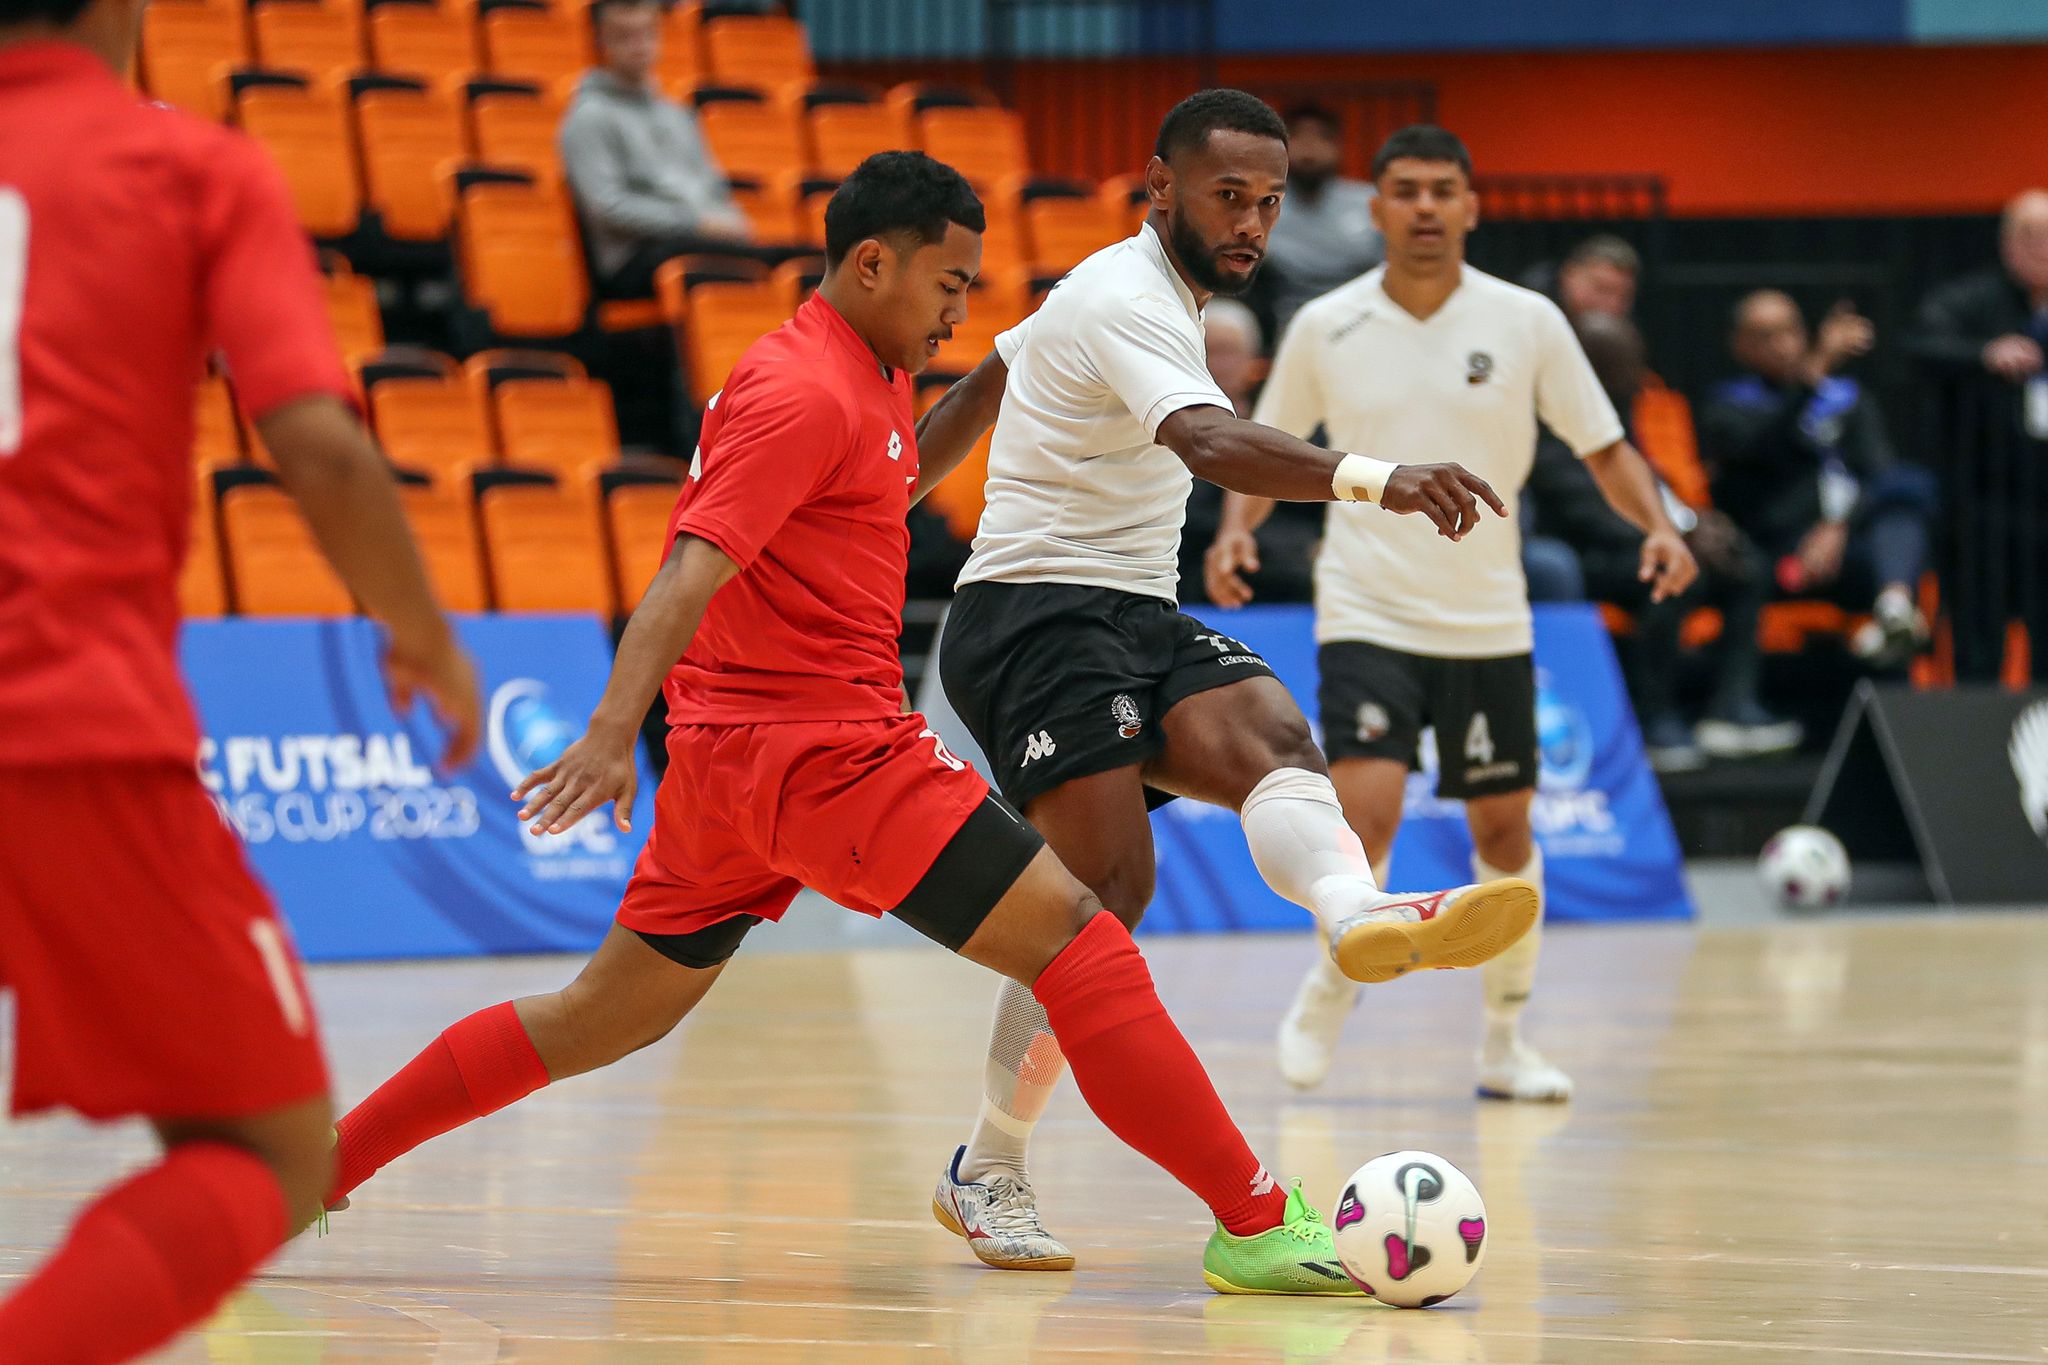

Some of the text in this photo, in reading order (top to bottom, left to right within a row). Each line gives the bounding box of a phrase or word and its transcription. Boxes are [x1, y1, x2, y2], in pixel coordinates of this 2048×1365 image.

[225, 732, 432, 793] FUTSAL
[1463, 710, 1496, 764] 4
[274, 791, 367, 843] CUP
[369, 785, 481, 841] 2023
